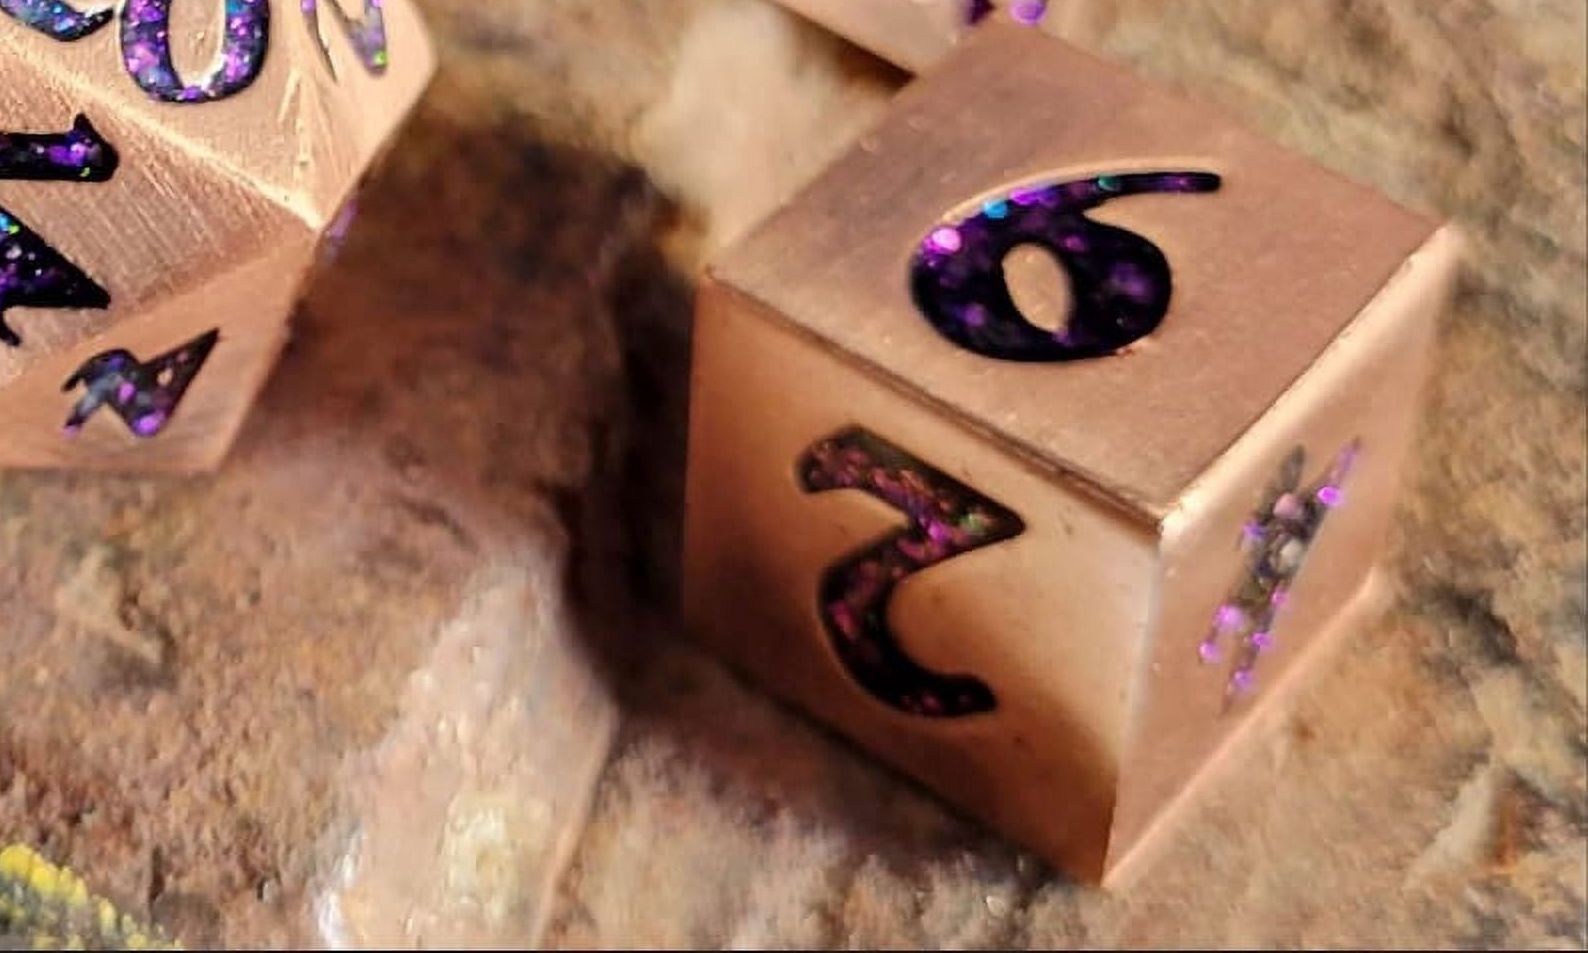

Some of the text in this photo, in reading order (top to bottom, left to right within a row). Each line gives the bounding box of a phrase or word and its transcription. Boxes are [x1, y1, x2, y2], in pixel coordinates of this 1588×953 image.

[910, 169, 1223, 363] 6
[62, 327, 222, 437] 4
[795, 426, 1027, 719] 2
